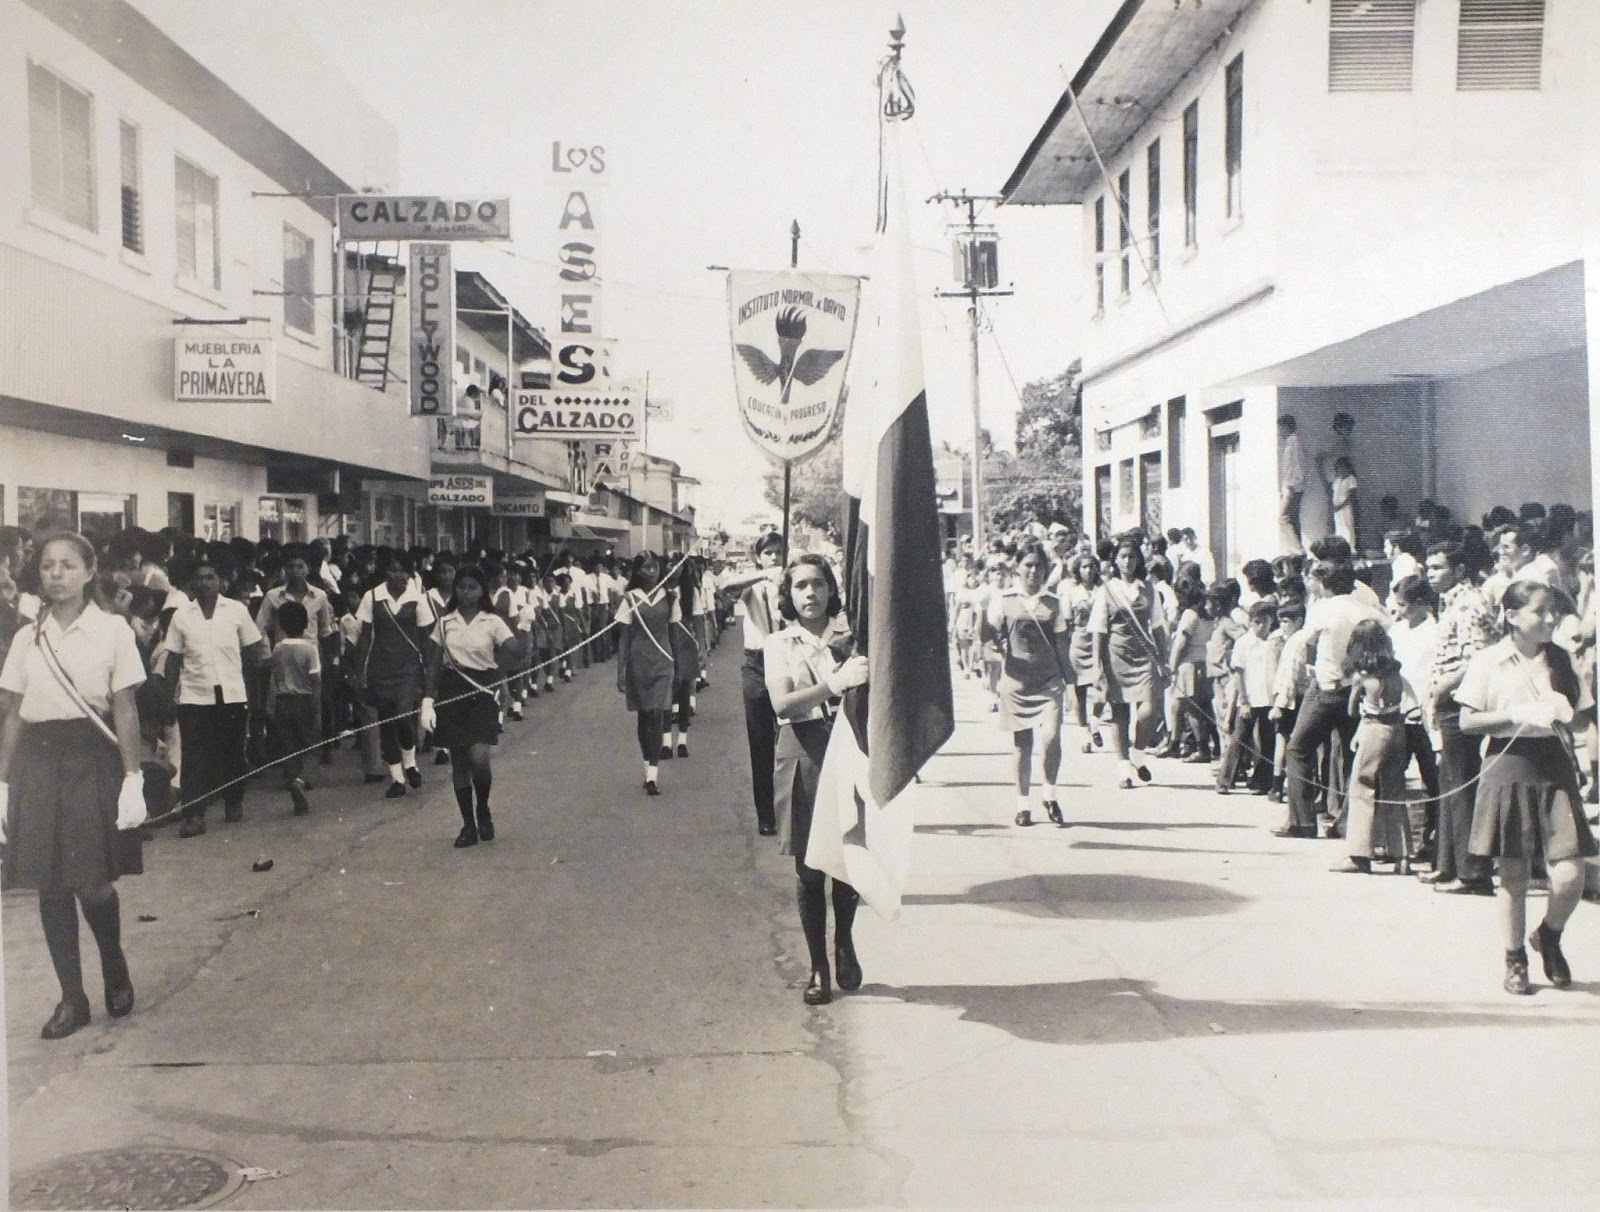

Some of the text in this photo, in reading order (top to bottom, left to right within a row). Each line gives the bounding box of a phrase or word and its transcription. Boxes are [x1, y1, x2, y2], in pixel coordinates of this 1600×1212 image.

[351, 200, 497, 223] CALZADO
[418, 256, 440, 415] HOLLYWOOD
[184, 342, 261, 355] MUEBLERIA
[208, 357, 235, 369] LA
[180, 370, 266, 396] PRIMAVERA
[519, 394, 547, 407] DEL
[517, 406, 635, 433] CALZADO
[430, 493, 486, 502] CALZADO
